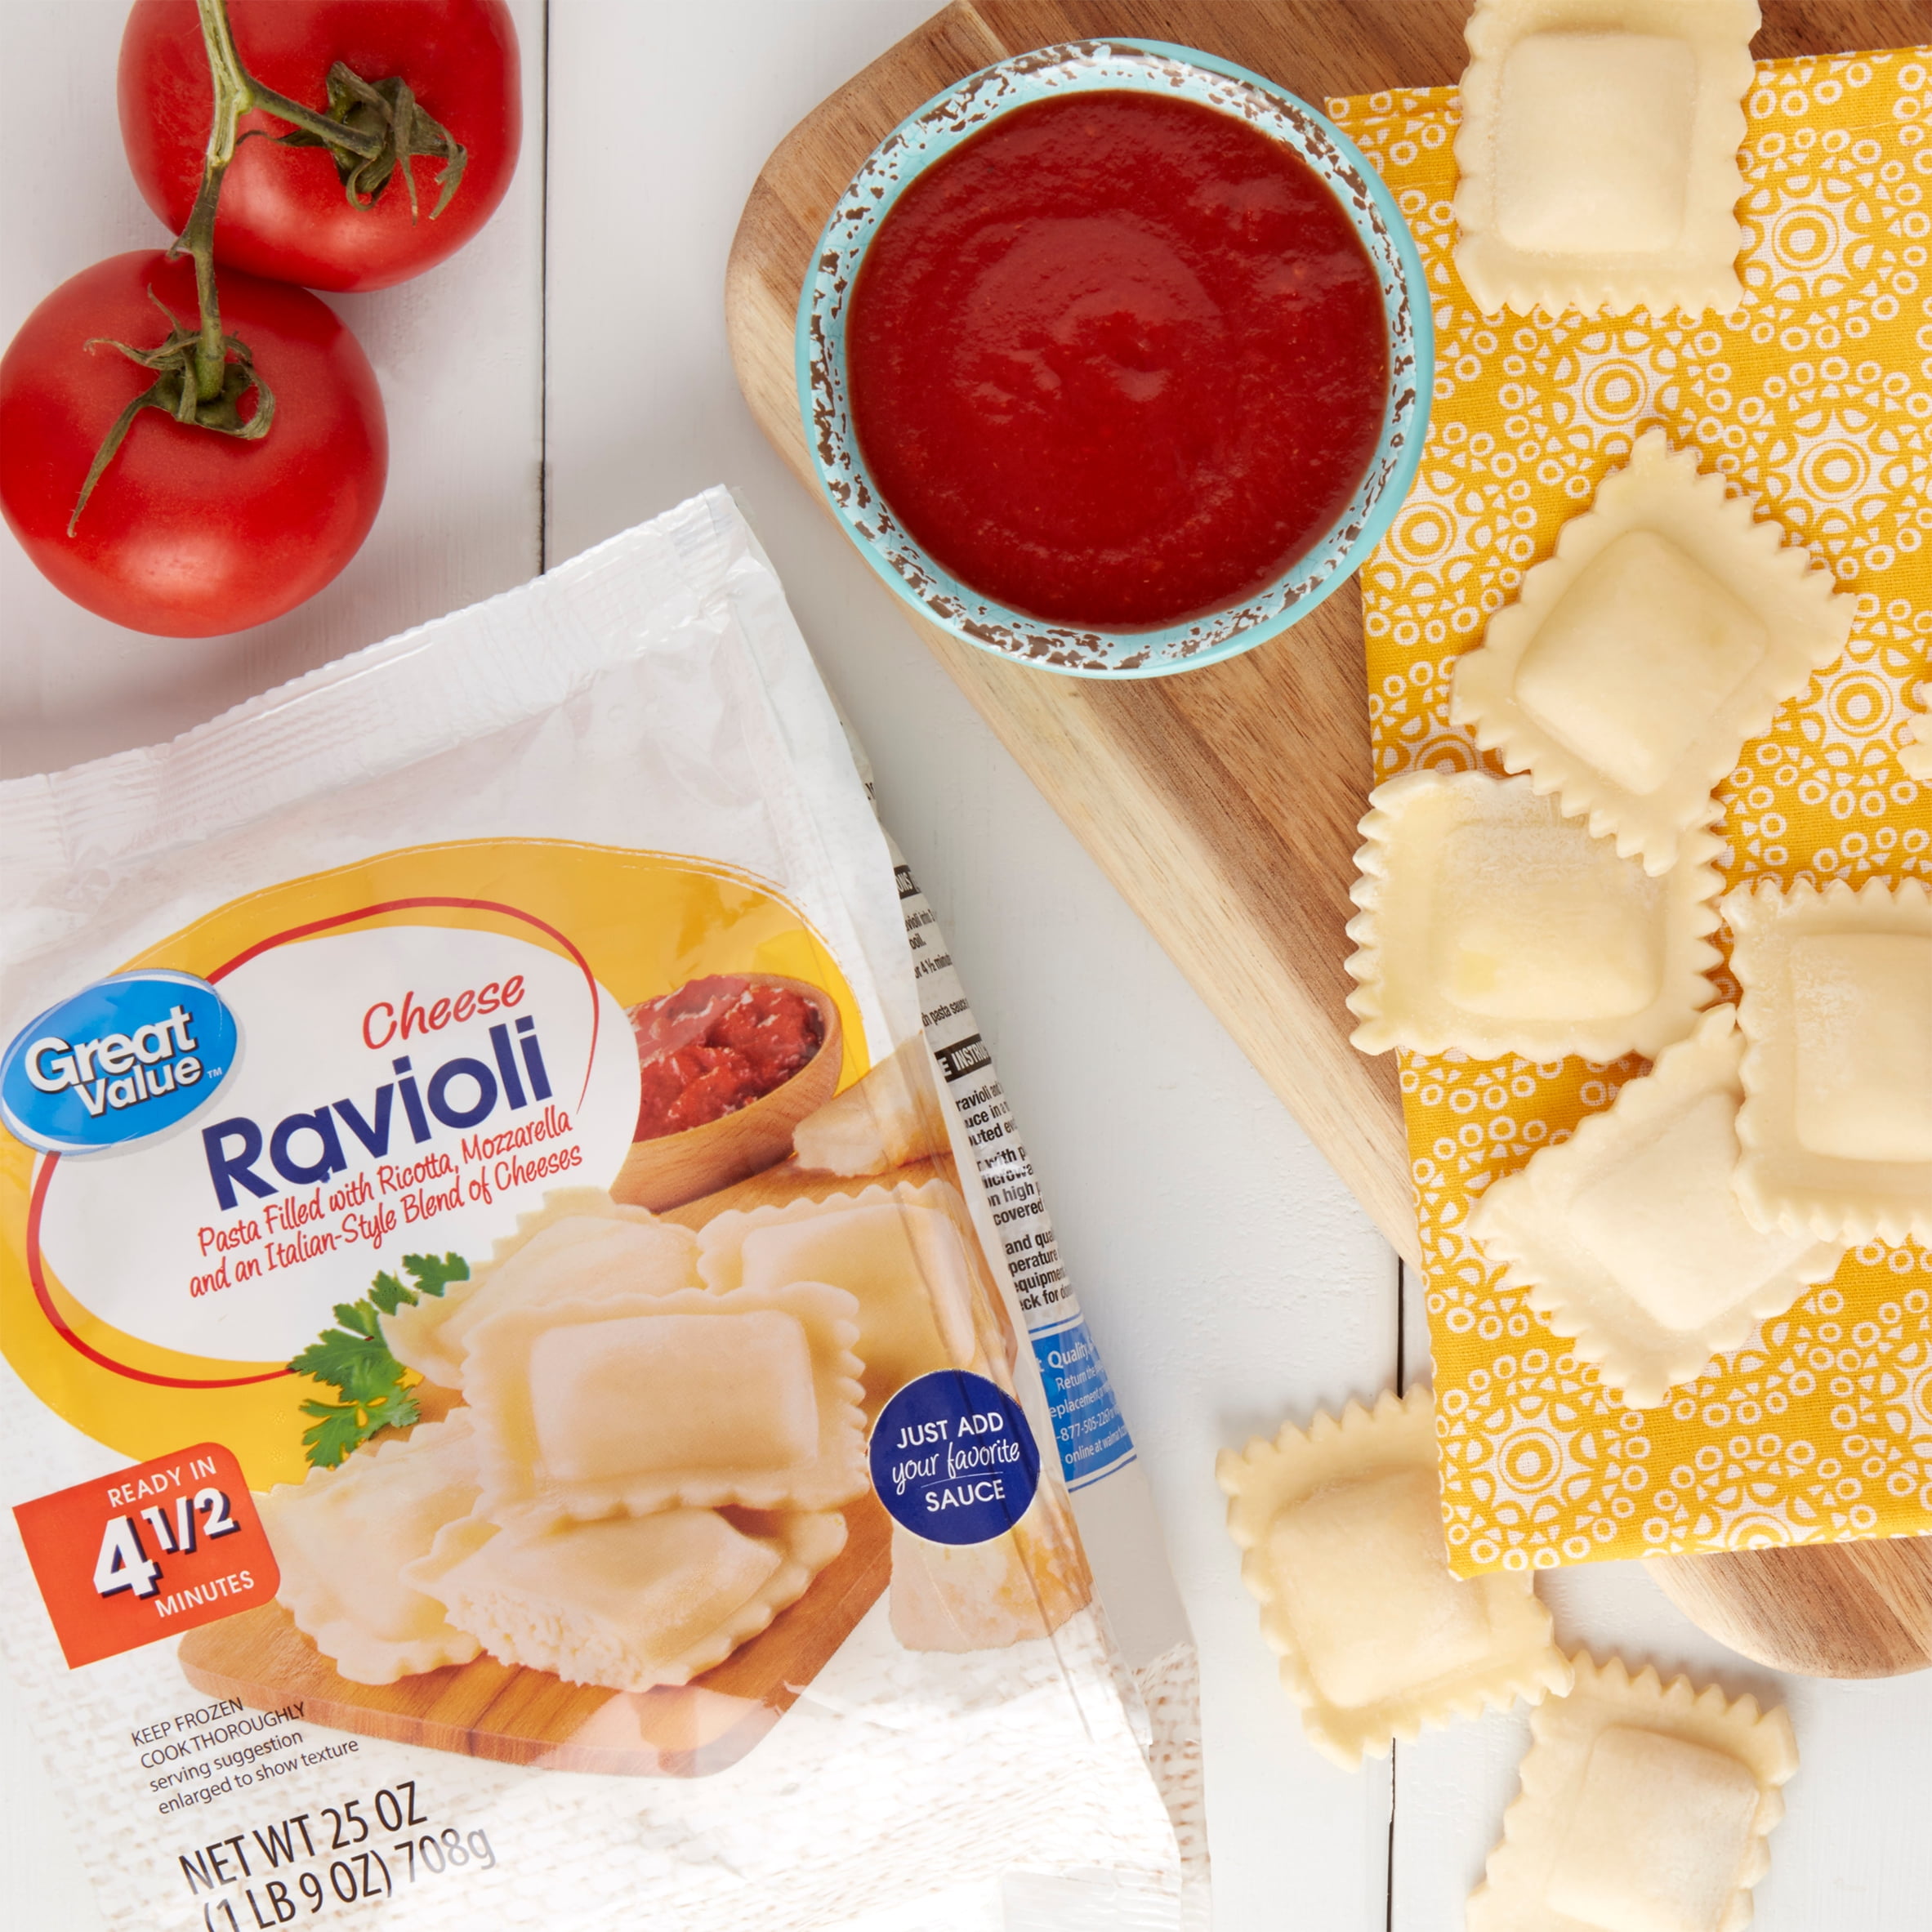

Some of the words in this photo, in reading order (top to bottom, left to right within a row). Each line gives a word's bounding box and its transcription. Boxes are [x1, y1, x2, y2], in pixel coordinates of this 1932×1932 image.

[920, 961, 930, 975] 4
[362, 975, 525, 1050] Cheese
[929, 1005, 952, 1026] pasta
[25, 1005, 198, 1093] Great
[74, 1054, 202, 1118] Value
[955, 1084, 993, 1112] ravioli
[201, 1015, 552, 1211] Ravioli
[988, 1104, 1002, 1119] in
[198, 1220, 262, 1257] Pasta
[263, 1187, 325, 1234] Filled
[328, 1171, 375, 1212] with
[376, 1153, 459, 1195] Ricotta,
[461, 1104, 573, 1164] Mozzarella
[984, 1149, 1018, 1169] with
[993, 1197, 1045, 1226] covered
[1002, 1181, 1035, 1203] high
[189, 1256, 232, 1298] and
[234, 1257, 263, 1283] an
[264, 1202, 397, 1271] Italian-Style
[399, 1175, 466, 1224] Blend
[468, 1165, 493, 1205] of
[494, 1145, 582, 1191] Cheeses
[1004, 1234, 1033, 1256] and
[1008, 1249, 1060, 1278] perature
[1042, 1289, 1060, 1305] for
[1047, 1341, 1090, 1369] Quality
[1055, 1371, 1087, 1392] Return
[896, 1419, 948, 1449] JUST
[957, 1412, 1004, 1439] ADD
[1064, 1445, 1095, 1465] online
[1094, 1439, 1104, 1453] at
[107, 1467, 181, 1508] READY
[190, 1455, 217, 1478] IN
[891, 1452, 939, 1496] your
[947, 1438, 1020, 1479] favorite
[925, 1479, 1006, 1512] SAUCE
[154, 1569, 255, 1618] MINUTES
[131, 1720, 172, 1747] KEEP
[174, 1697, 244, 1733] FROZEN
[141, 1740, 192, 1769] COOK
[190, 1701, 306, 1752] THOROUGHLY
[149, 1761, 212, 1792] serving
[213, 1731, 304, 1770] suggestion
[158, 1776, 233, 1814] enlarged
[234, 1773, 253, 1788] to
[256, 1757, 298, 1782] show
[301, 1739, 359, 1768] texture
[178, 1834, 252, 1895] NET
[252, 1814, 315, 1868] WT
[320, 1799, 369, 1850] 25
[374, 1780, 427, 1833] OZ
[245, 1881, 297, 1930] LB
[298, 1872, 324, 1914] 9
[329, 1849, 393, 1904] OZ)
[394, 1827, 497, 1884] 708g
